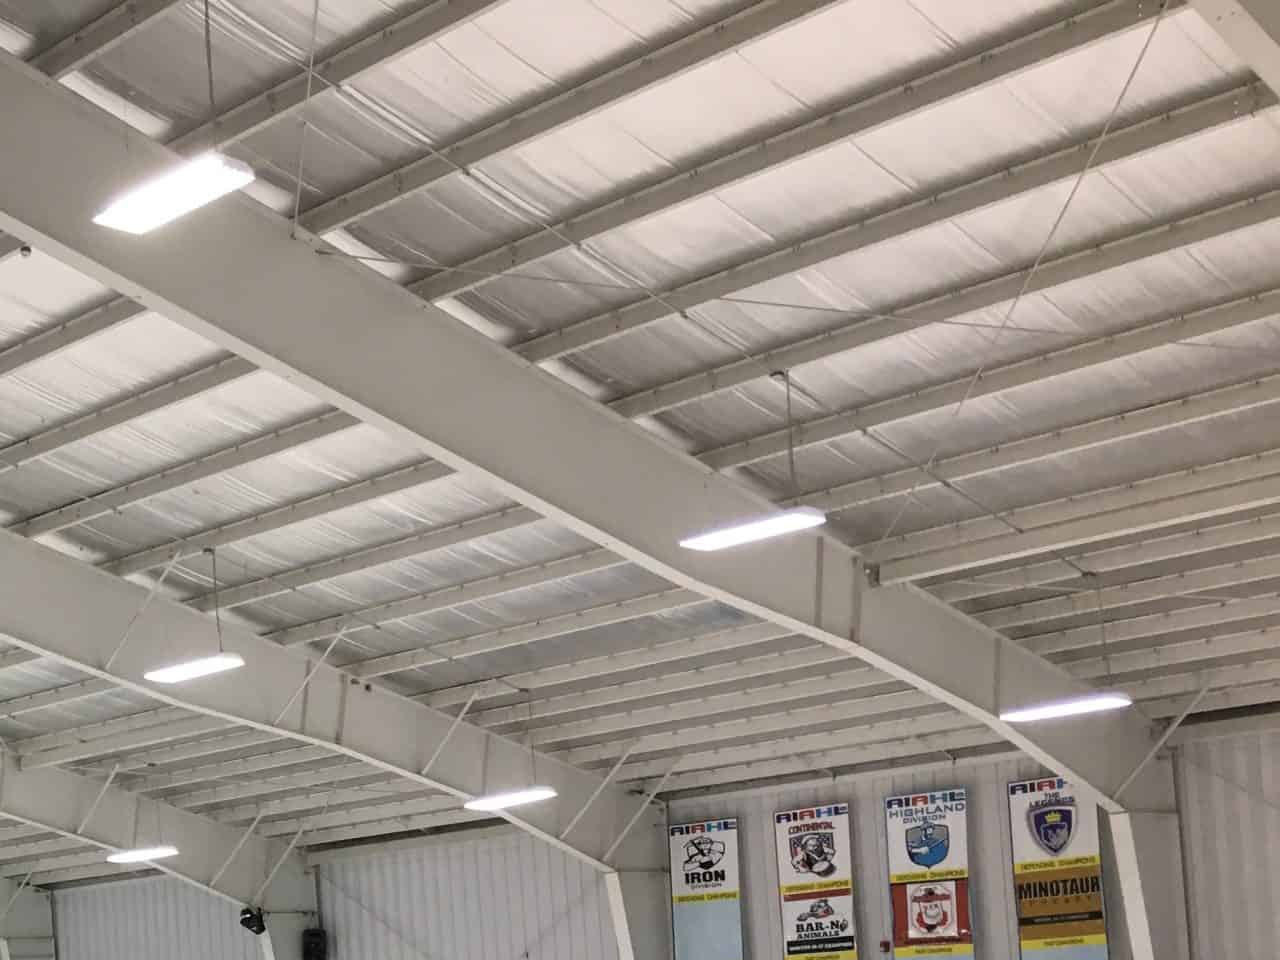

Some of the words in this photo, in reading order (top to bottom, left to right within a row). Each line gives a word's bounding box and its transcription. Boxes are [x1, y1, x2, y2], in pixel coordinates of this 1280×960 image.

[889, 802, 965, 818] HIGHLAND
[685, 870, 726, 884] IRON
[1018, 876, 1100, 899] MINOTAUR
[797, 930, 840, 939] ANIMALS
